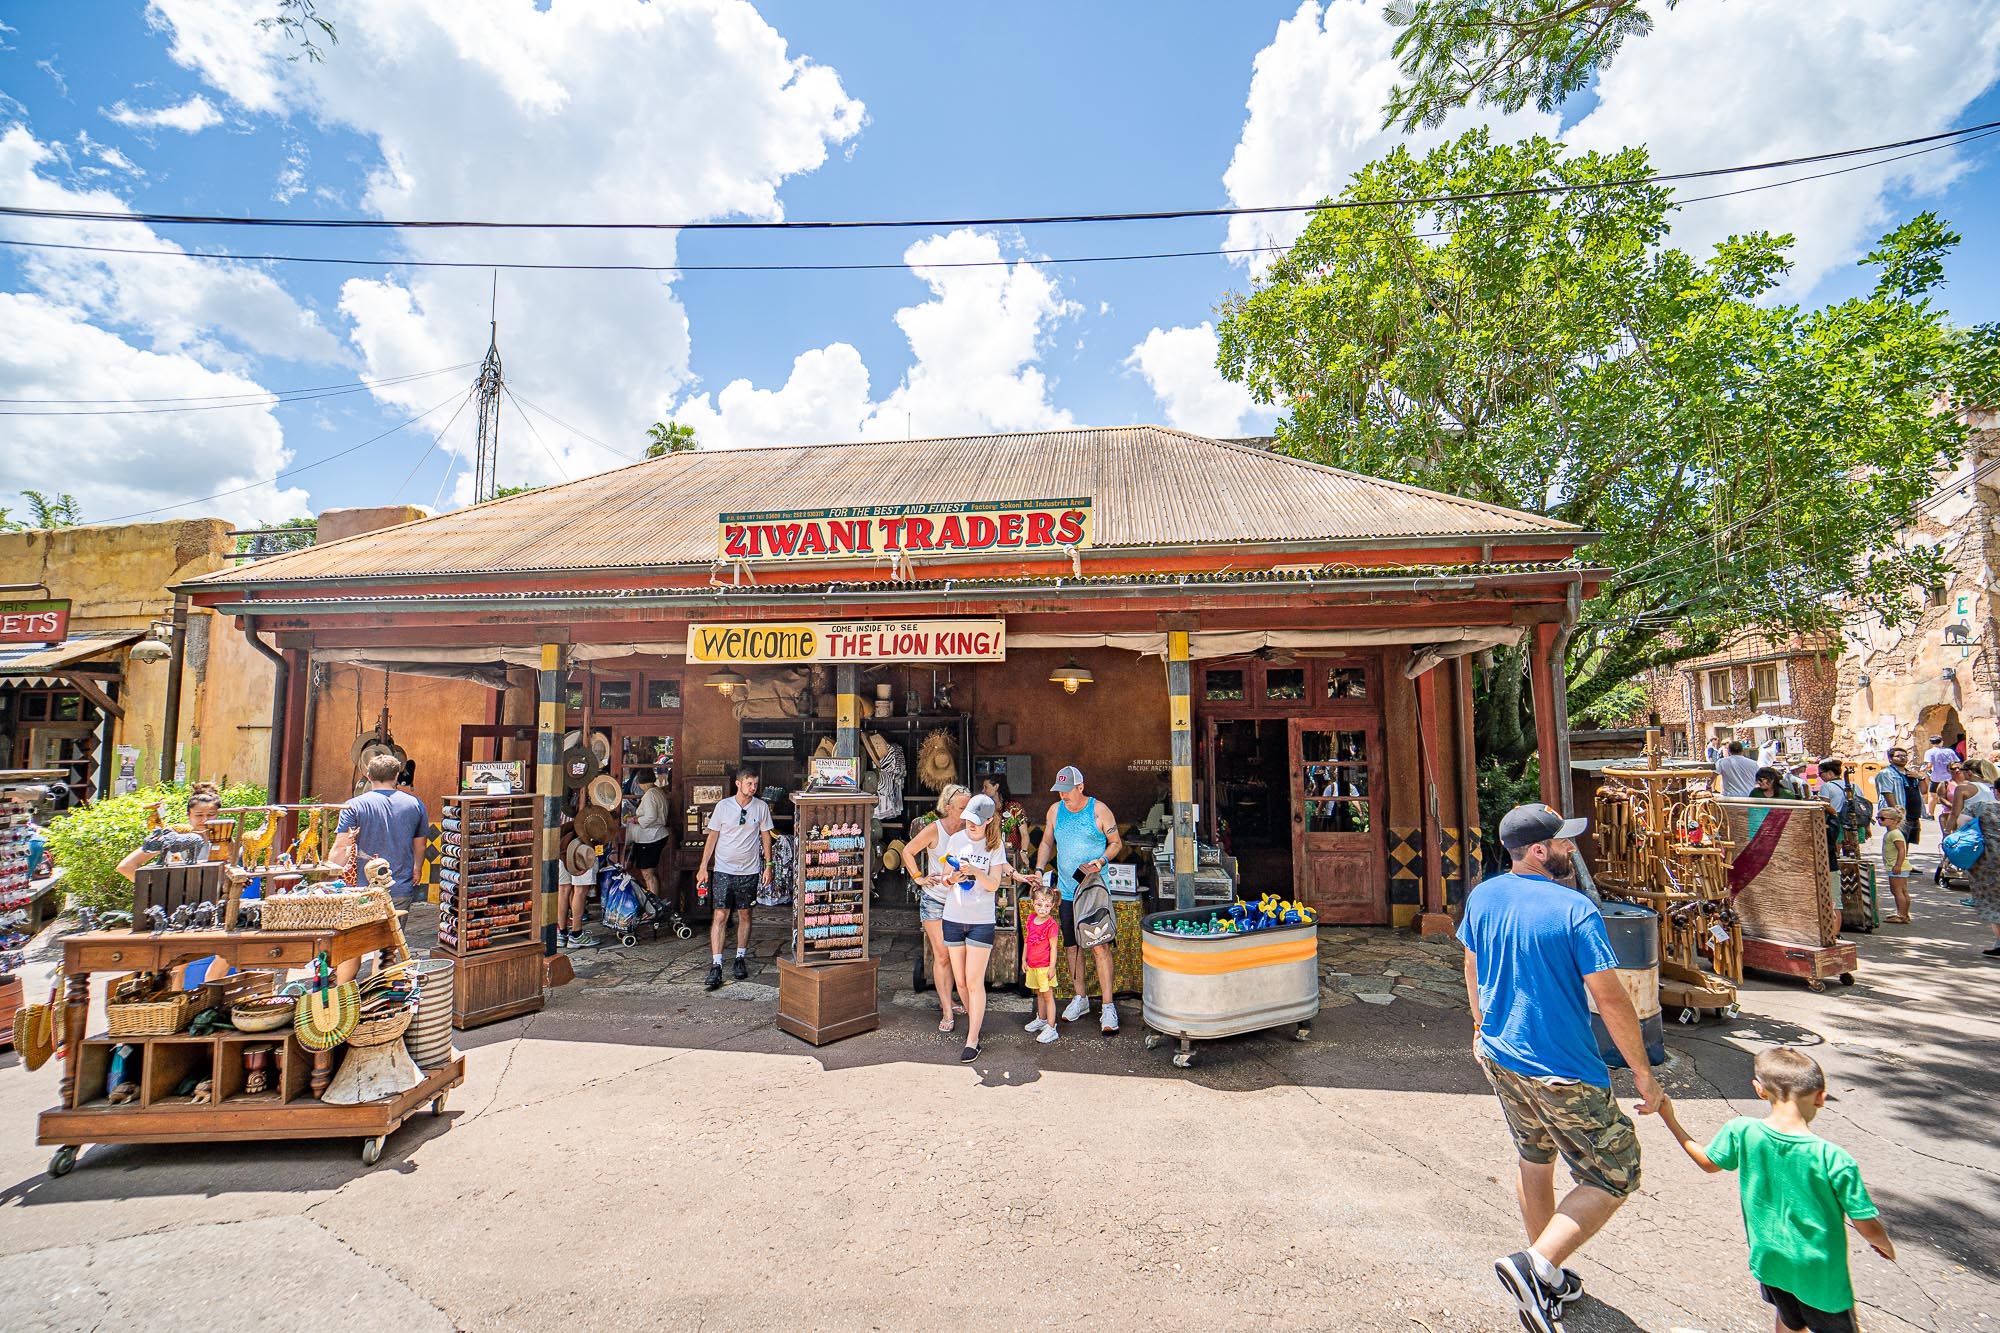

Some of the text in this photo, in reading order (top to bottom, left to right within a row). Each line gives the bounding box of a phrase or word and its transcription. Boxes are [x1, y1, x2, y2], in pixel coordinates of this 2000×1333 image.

[829, 503, 967, 518] FOR THE BEST AND FINEST
[1000, 501, 1022, 509] Sokoni
[1035, 499, 1068, 508] Industrial
[725, 510, 1086, 558] ZIWANI TRADERS
[0, 612, 58, 634] ETS
[831, 625, 852, 633] COME
[856, 624, 882, 632] INSIDE
[884, 624, 896, 632] TO
[701, 628, 814, 658] Welcome
[825, 632, 1001, 657] THE LION KING!
[1085, 933, 1112, 946] adidas
